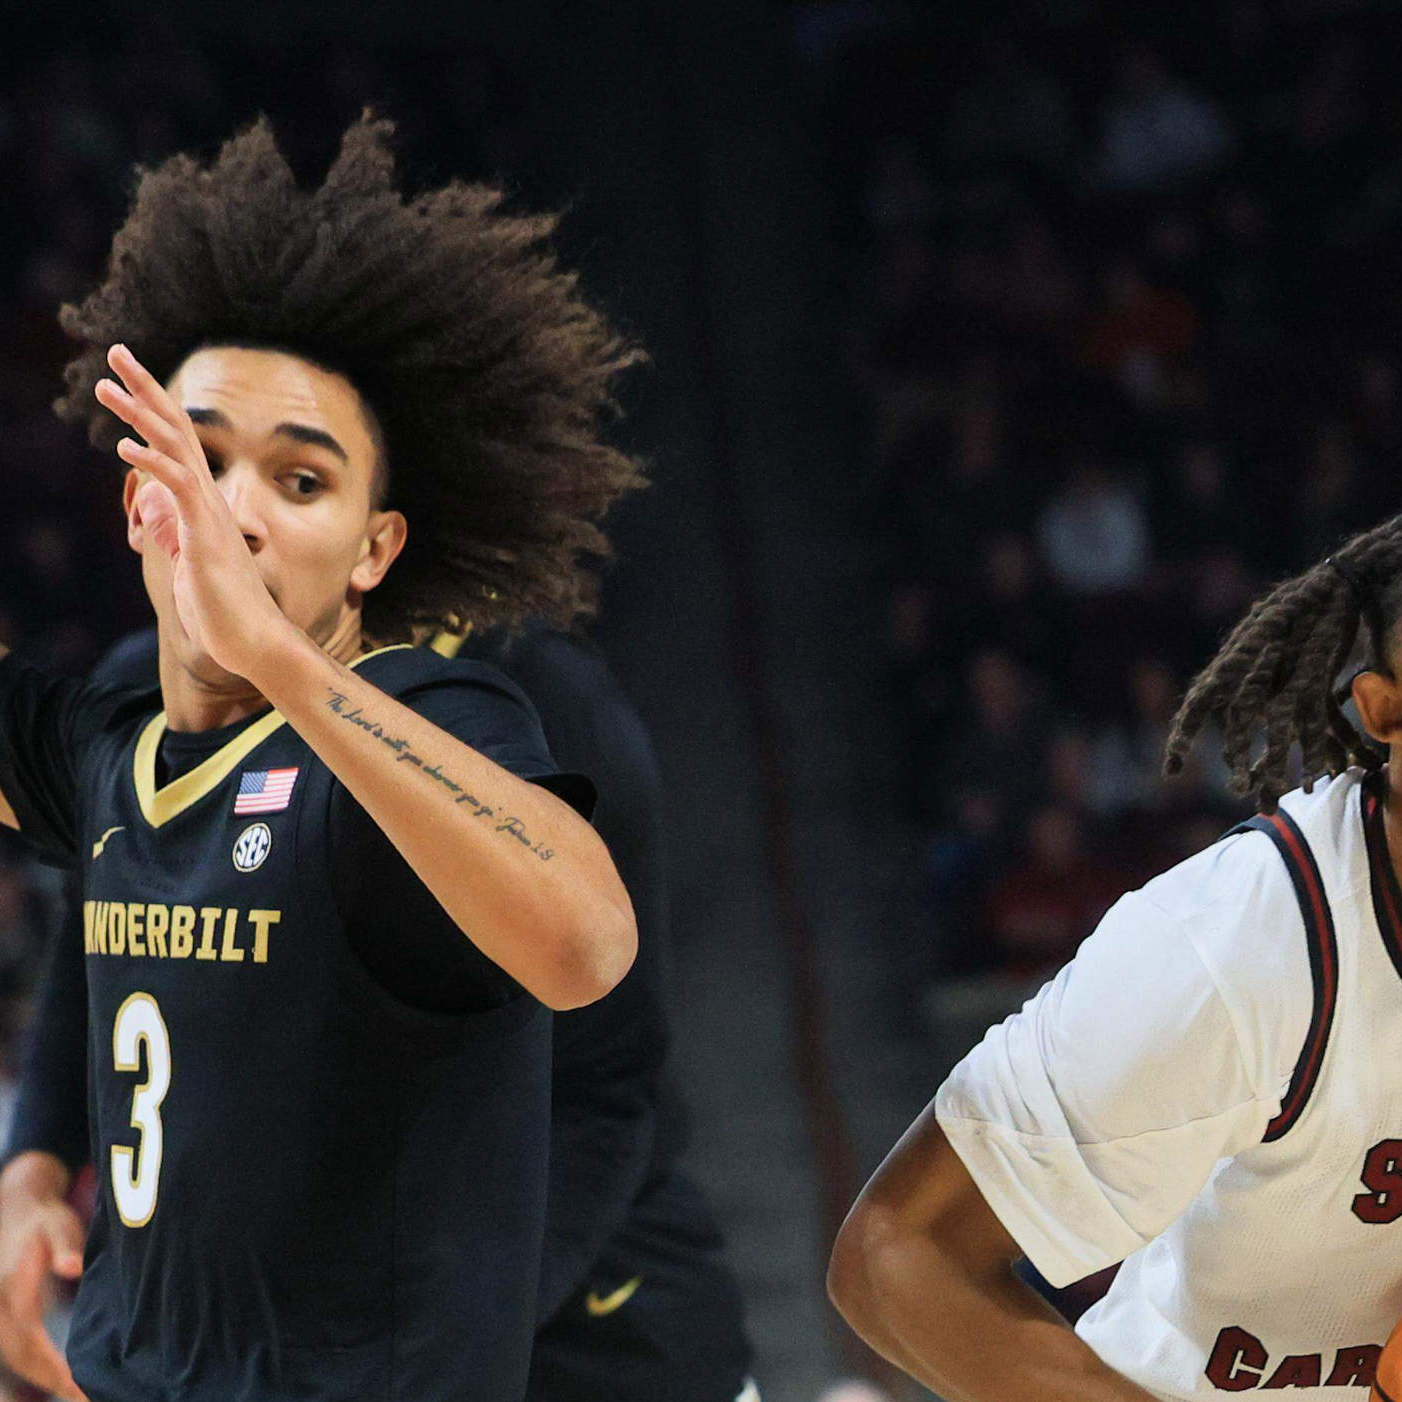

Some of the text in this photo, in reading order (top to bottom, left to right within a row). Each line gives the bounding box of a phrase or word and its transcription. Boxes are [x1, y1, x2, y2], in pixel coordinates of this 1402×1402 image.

[234, 825, 271, 870] SEC
[83, 900, 282, 964] NDERBILT
[110, 990, 172, 1228] 3
[1204, 1325, 1383, 1392] CAR
